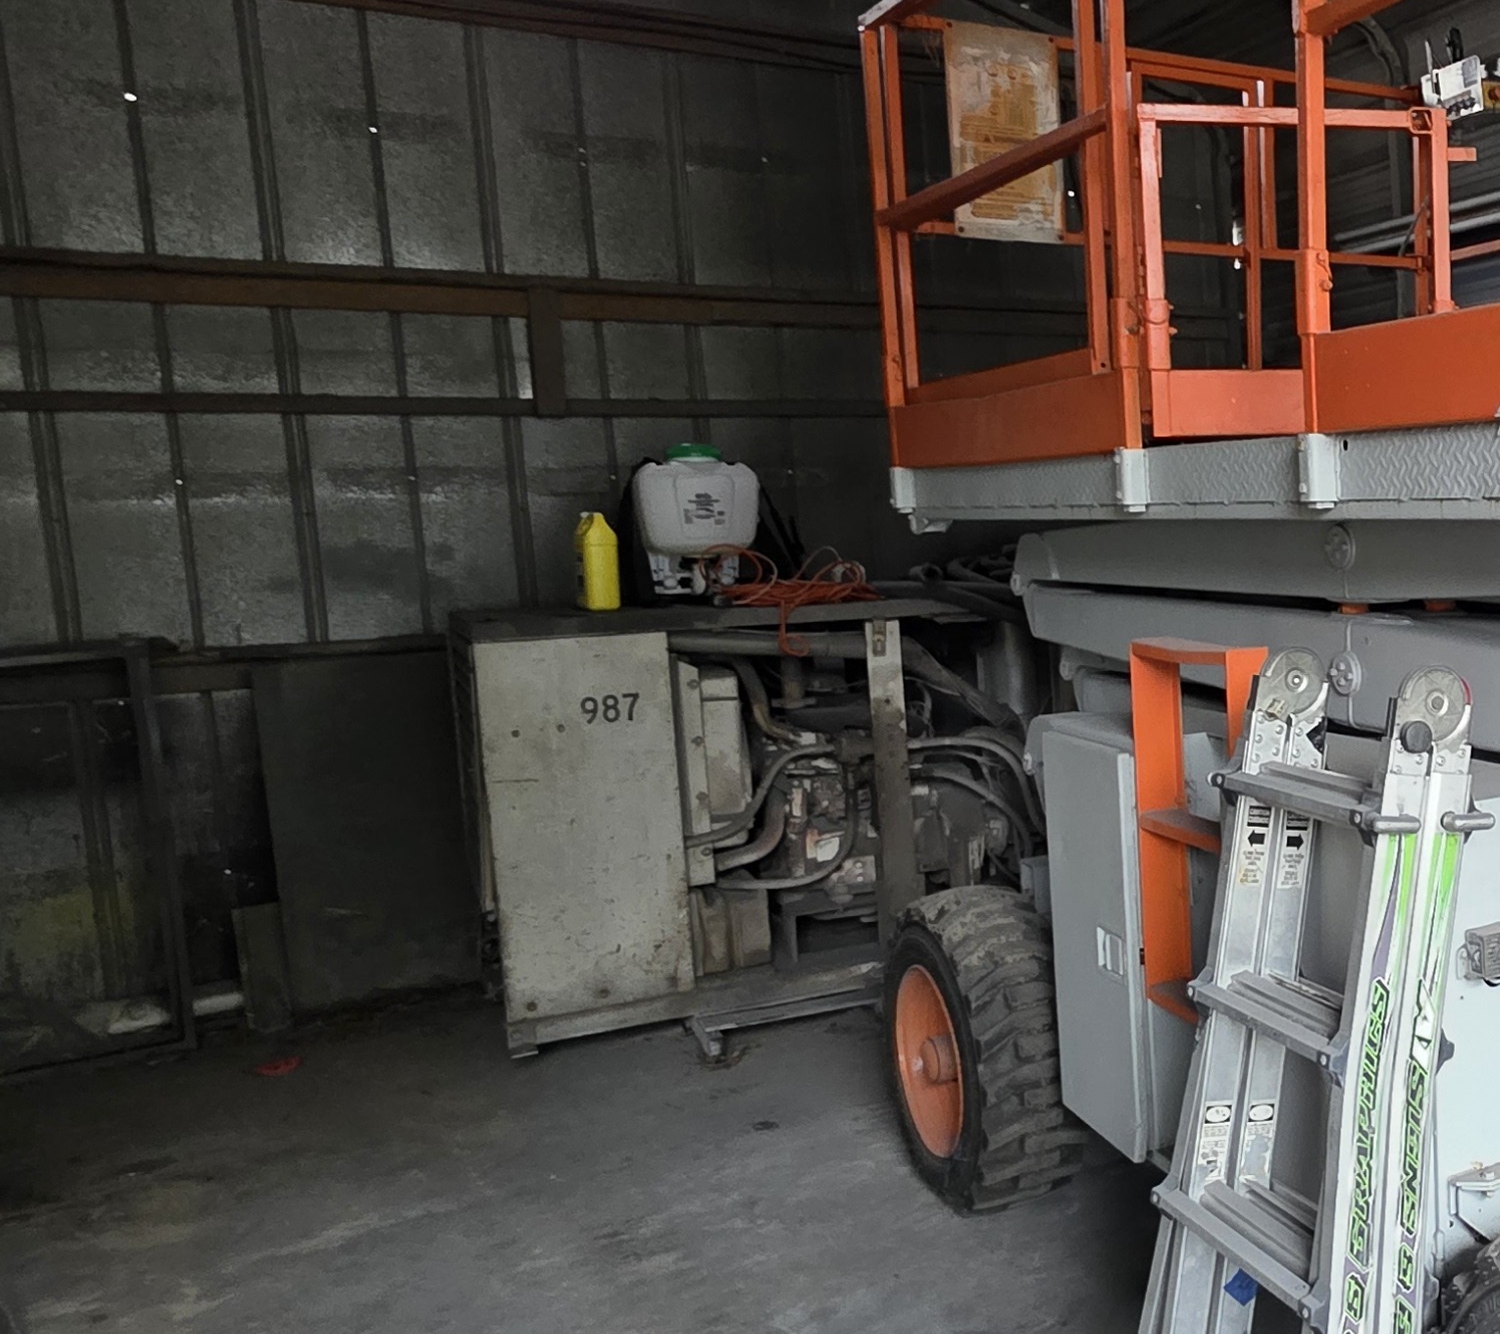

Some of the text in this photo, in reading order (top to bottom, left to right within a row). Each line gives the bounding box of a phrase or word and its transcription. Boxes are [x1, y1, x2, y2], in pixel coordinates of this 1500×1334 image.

[580, 692, 640, 725] 987
[1347, 978, 1389, 1271] GRAPHICS
[1401, 1059, 1427, 1237] SIGNS
